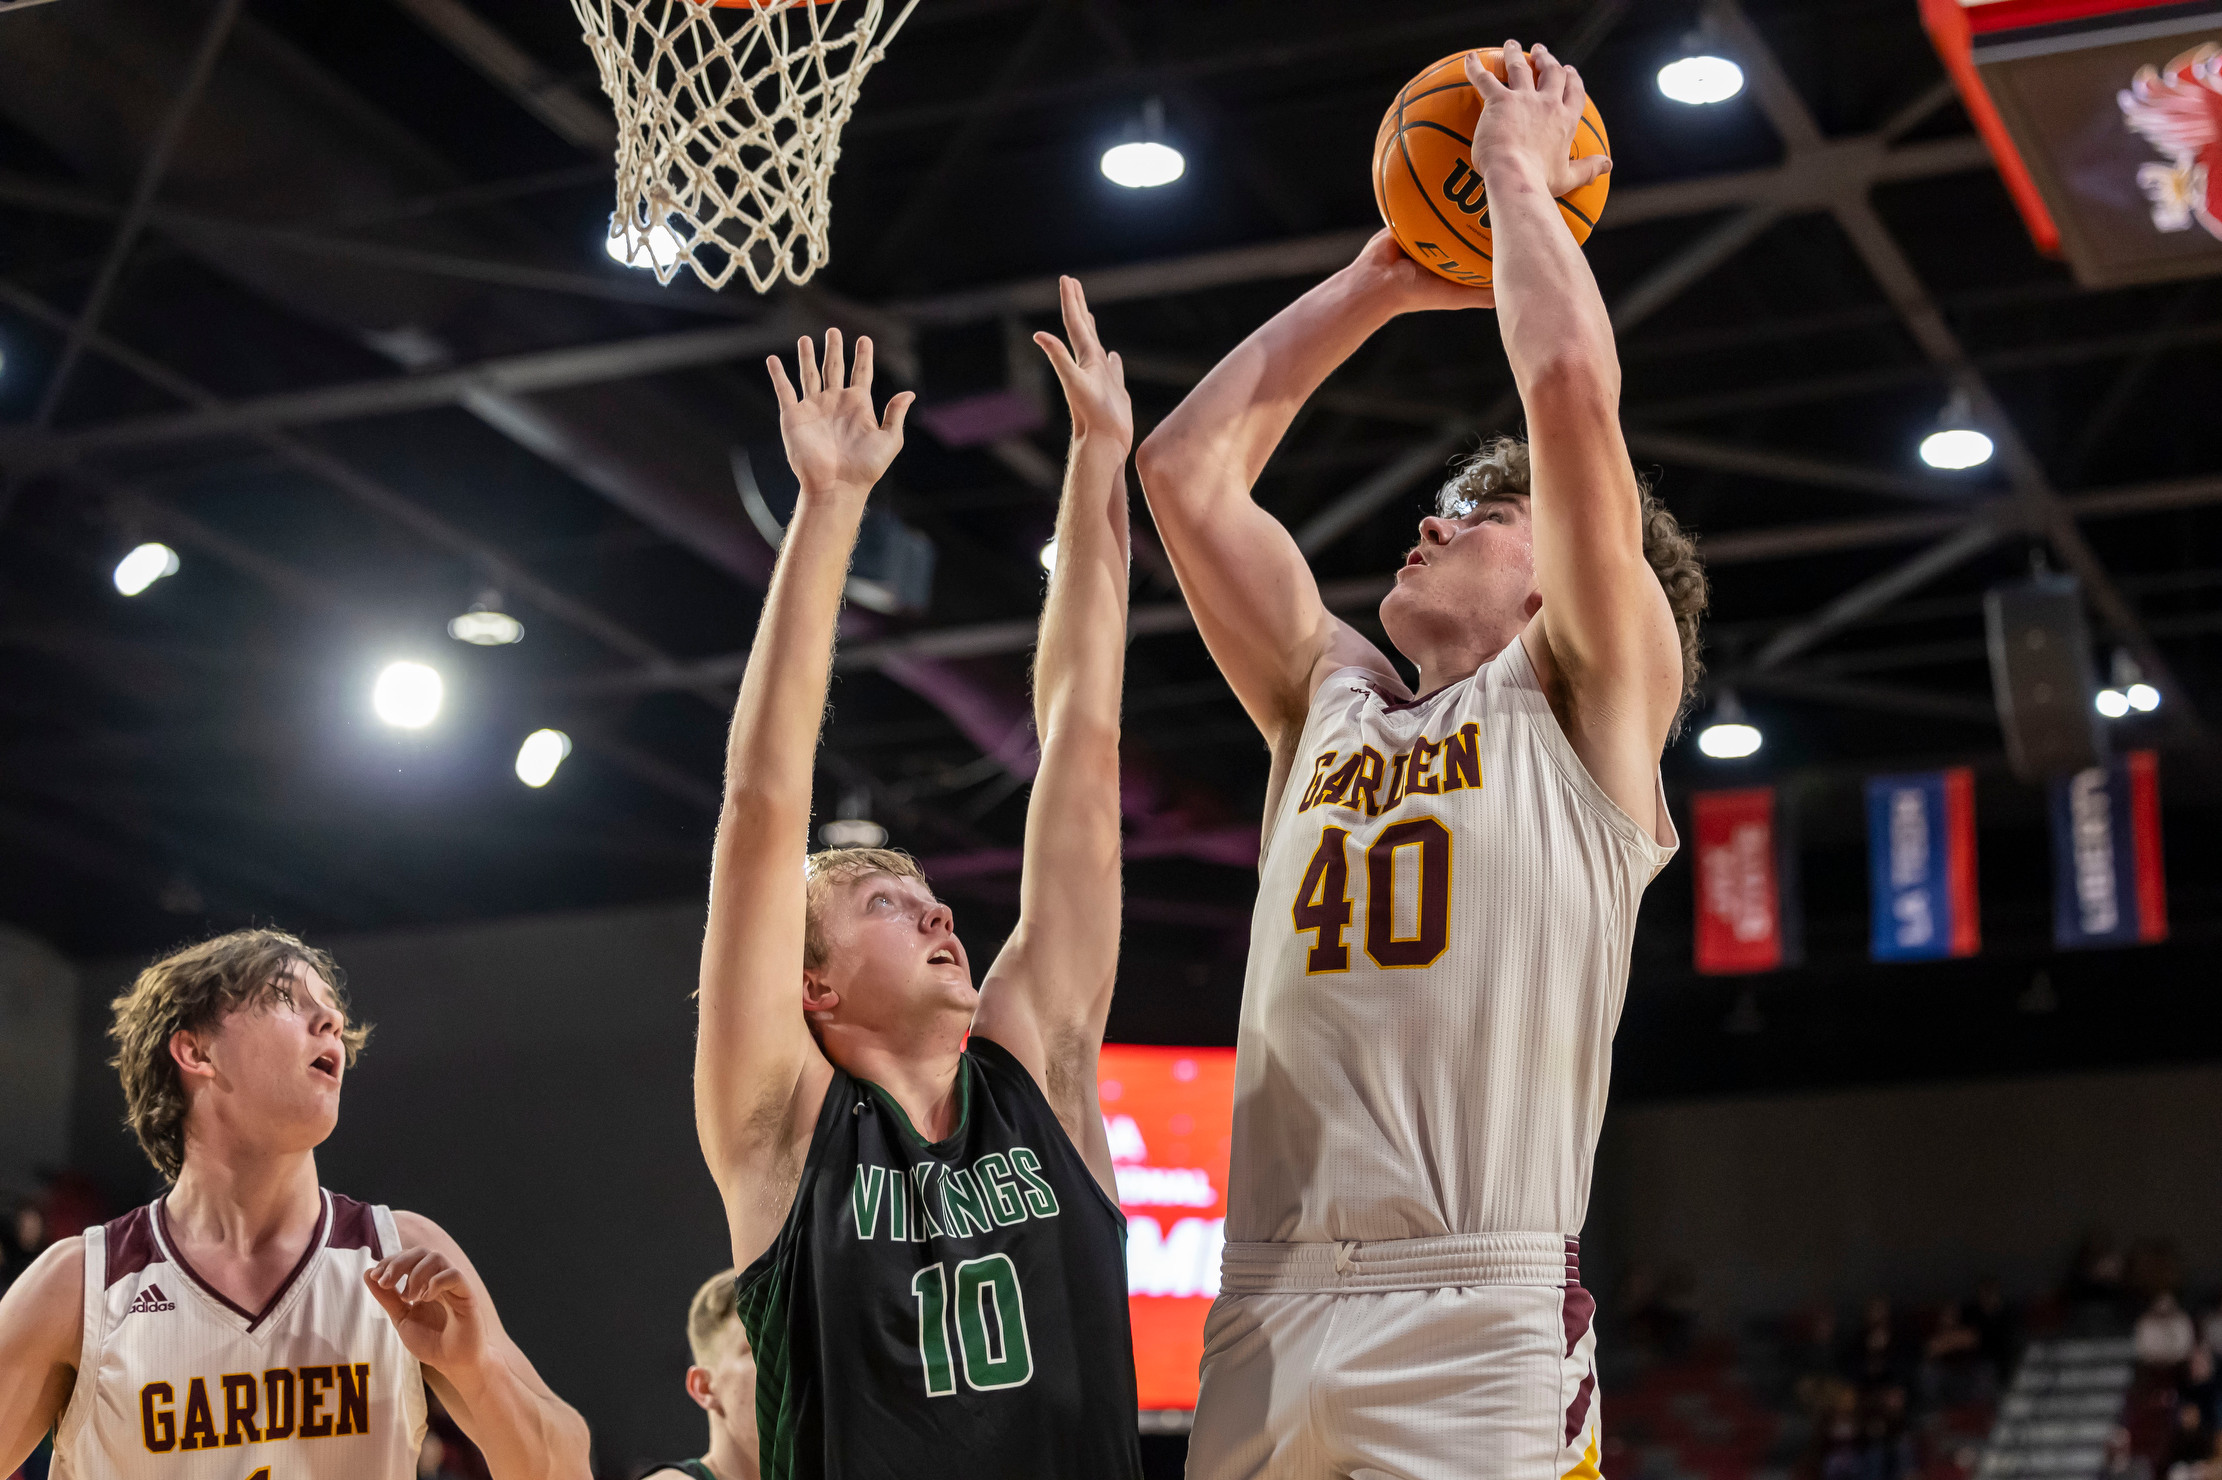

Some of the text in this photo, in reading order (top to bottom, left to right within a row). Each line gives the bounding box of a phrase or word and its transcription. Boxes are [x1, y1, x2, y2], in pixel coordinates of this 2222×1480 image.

[1291, 815, 1453, 977] 40
[852, 1146, 1061, 1243] VIKINGS
[128, 1301, 177, 1315] adidas
[911, 1252, 1034, 1398] 10
[139, 1362, 371, 1455] GARDEN
